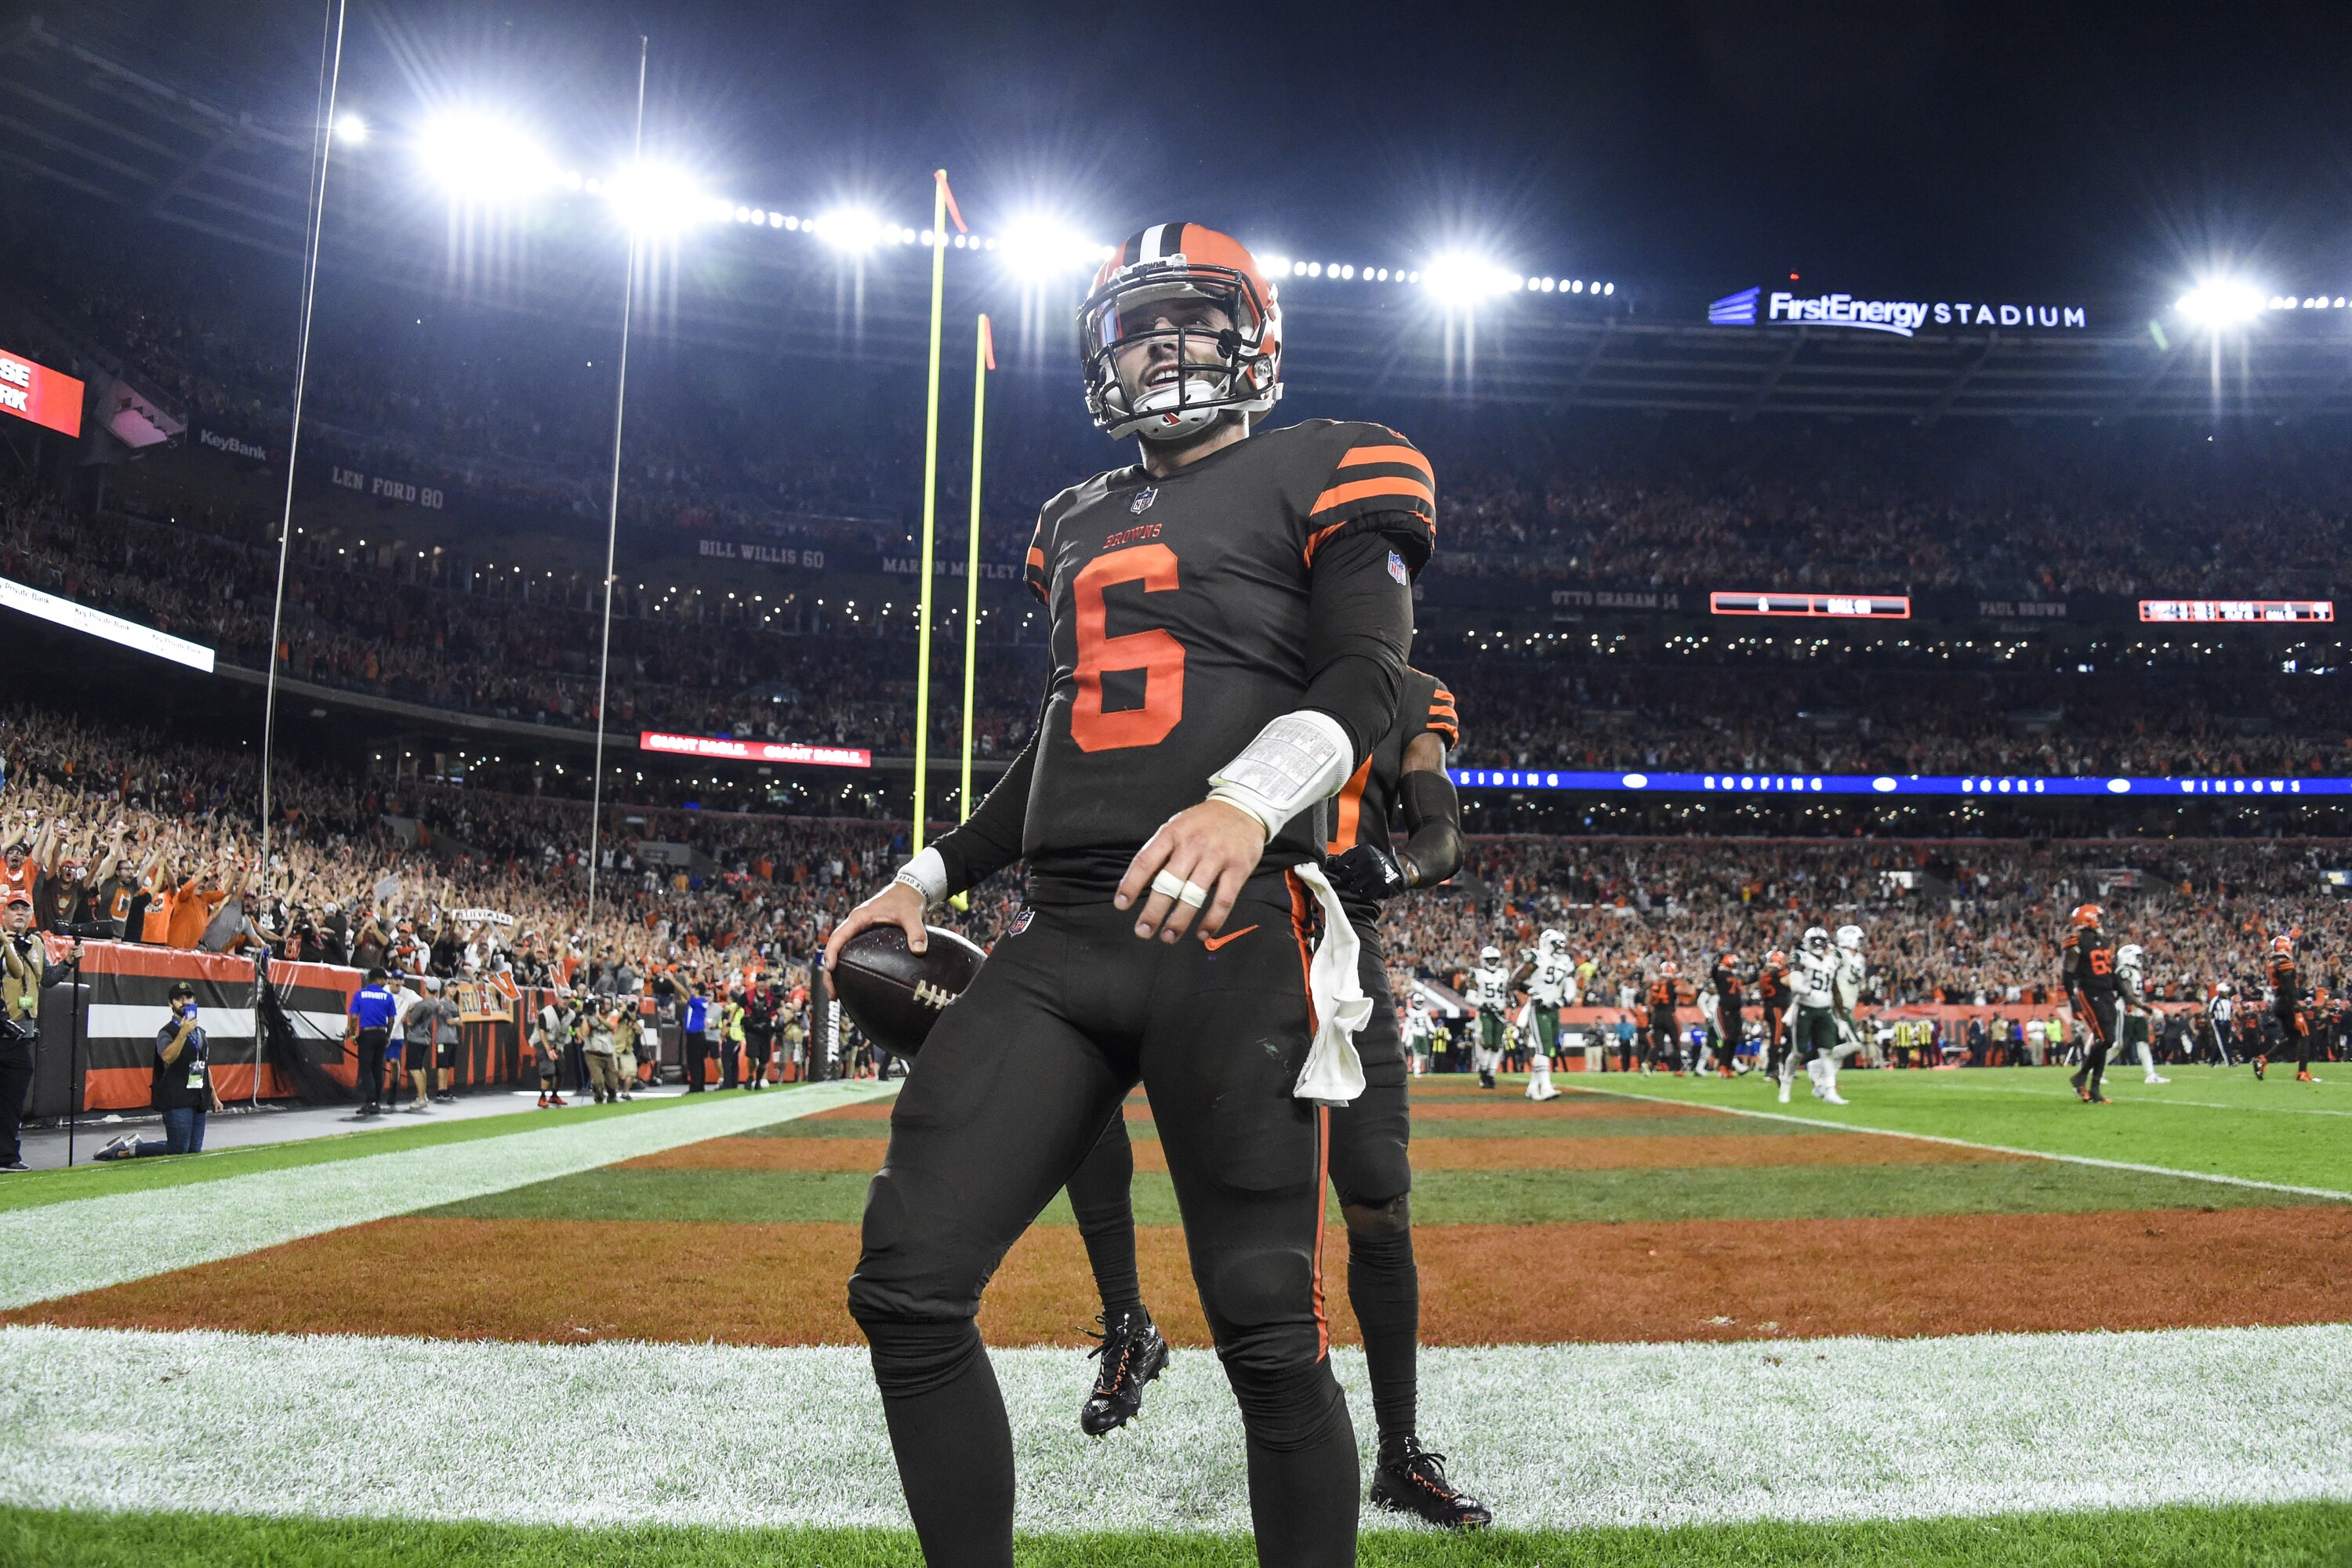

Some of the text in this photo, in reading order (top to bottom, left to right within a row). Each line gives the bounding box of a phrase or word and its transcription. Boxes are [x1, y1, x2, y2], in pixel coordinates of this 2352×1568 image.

[1769, 292, 2086, 328] FirstEnergy STADIUM
[200, 429, 267, 461] KeyBank
[332, 466, 364, 490] LEN
[372, 476, 416, 503] FORD
[1103, 523, 1162, 549] BROWNS
[699, 539, 735, 559] BILL
[741, 543, 797, 565] WILLIS
[883, 557, 1018, 579] MARN MTLEY
[4, 583, 30, 598] Private
[31, 592, 50, 604] Bank
[89, 612, 111, 626] Private
[1071, 543, 1185, 753] 6
[649, 735, 698, 752] GIANT
[764, 746, 812, 761] GIANT
[1460, 771, 1823, 791] SIDING ROOFING
[1961, 778, 2300, 794] DOORS WINDOWS
[489, 971, 522, 1001] V
[1544, 966, 1566, 985] 97
[1811, 970, 1830, 992] 51
[1485, 982, 1503, 999] 54
[827, 1000, 840, 1063] OOTBALL
